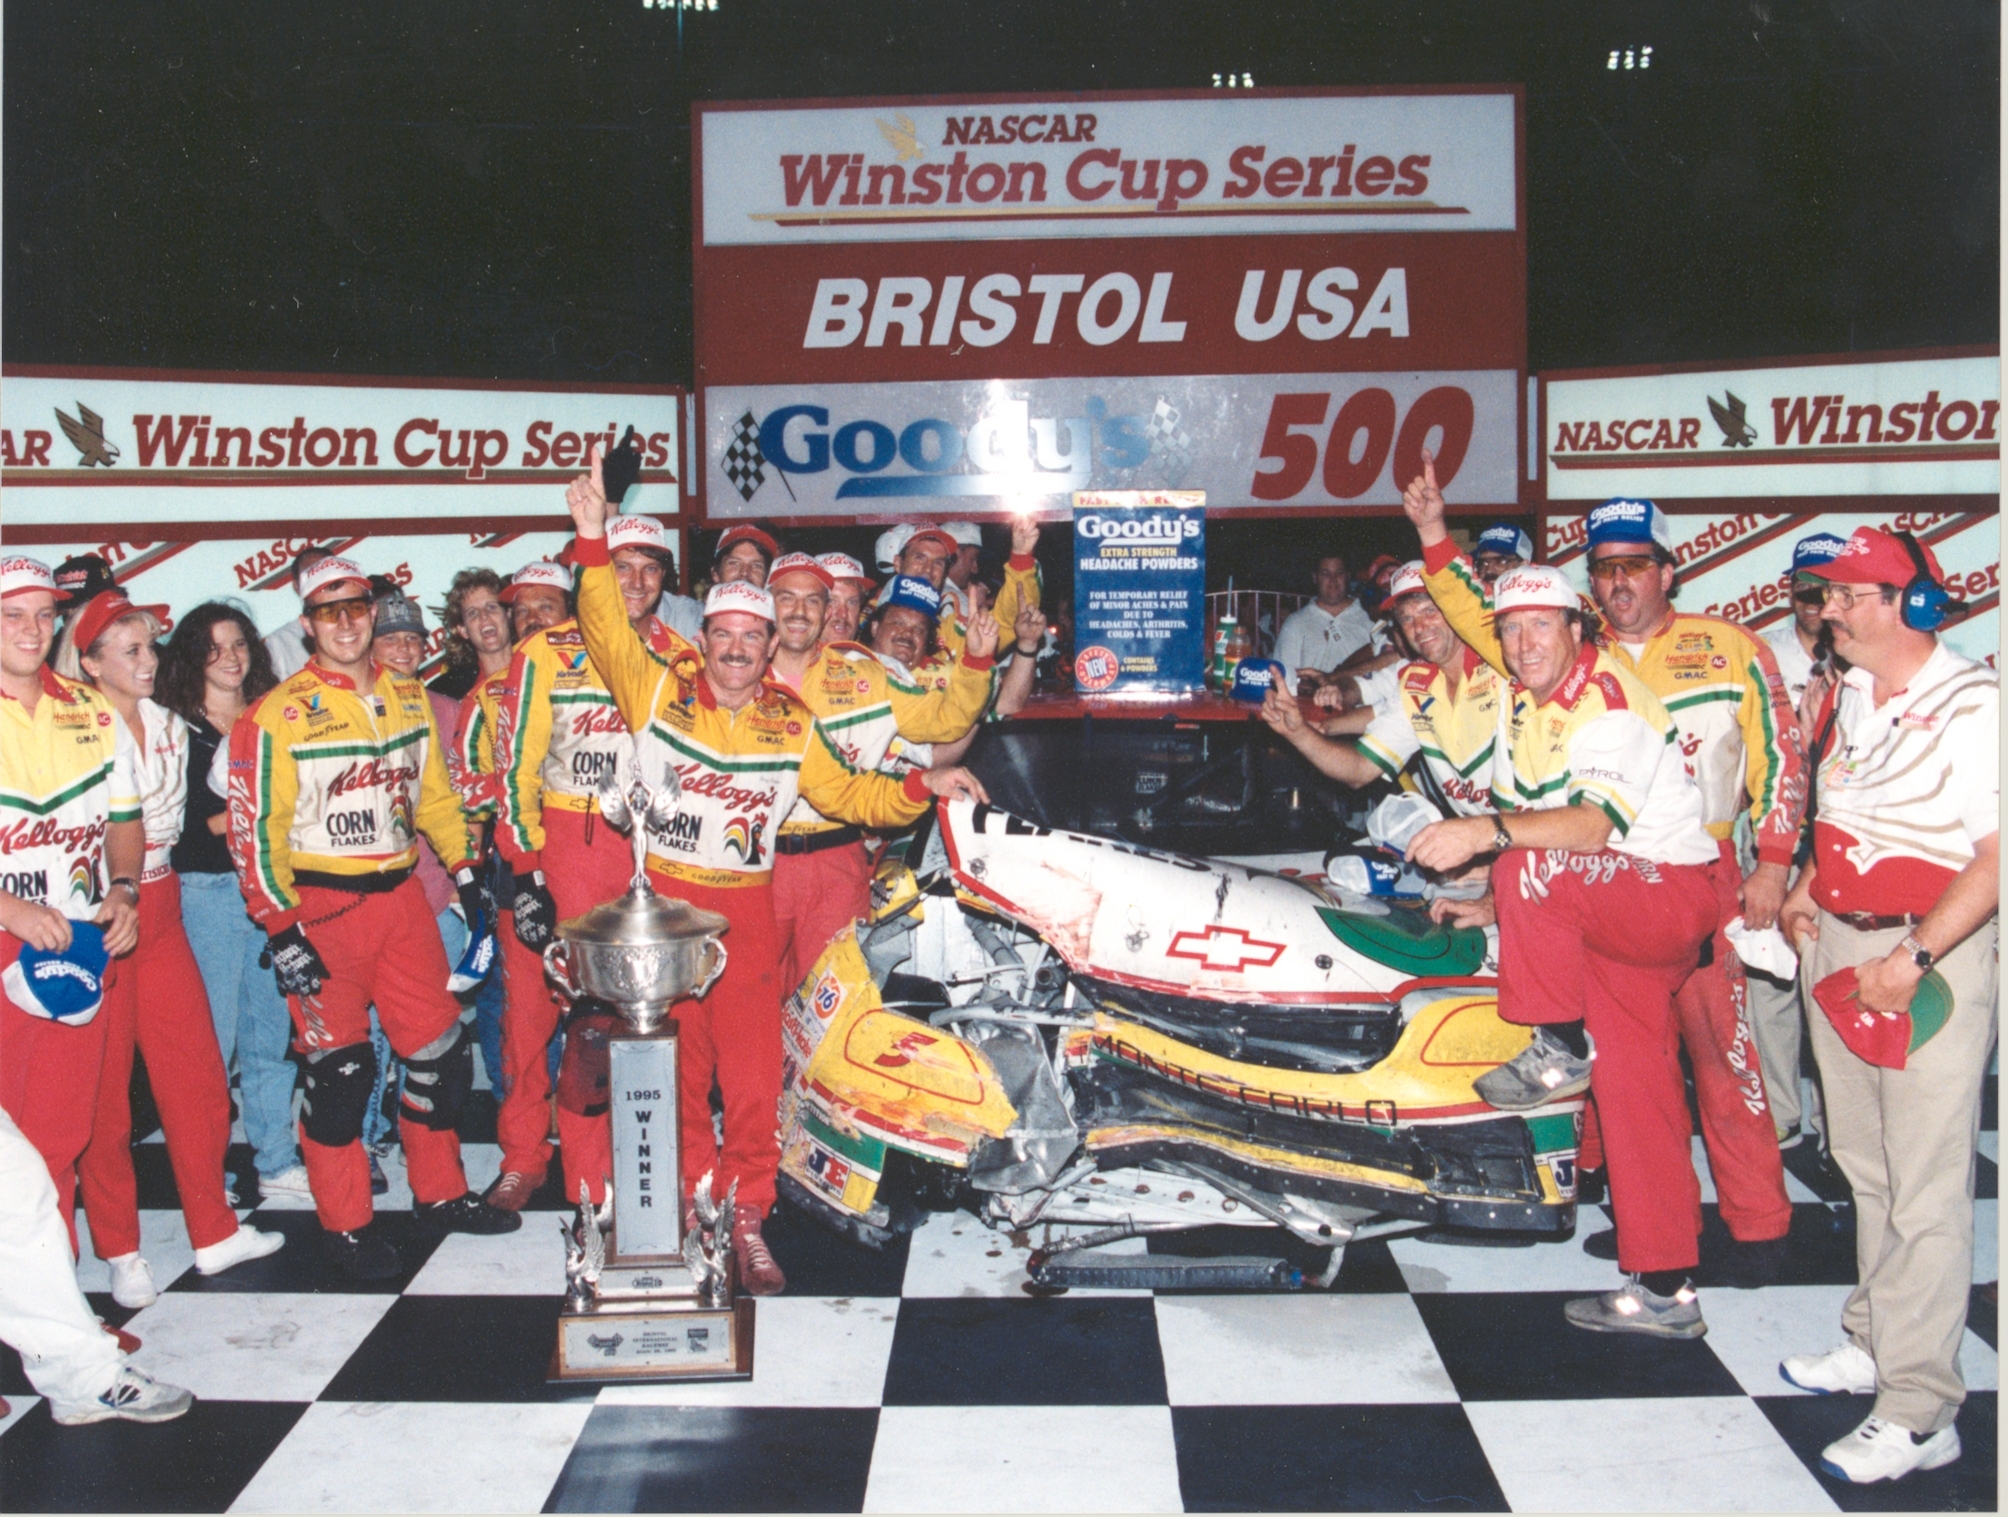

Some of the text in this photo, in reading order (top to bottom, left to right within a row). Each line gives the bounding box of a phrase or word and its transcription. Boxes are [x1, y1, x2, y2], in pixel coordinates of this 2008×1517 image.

[943, 114, 1097, 145] NASCAR
[779, 144, 1431, 211] Winston Cup Series
[803, 266, 1411, 349] BRISTOL USA
[760, 385, 1476, 501] Goody's 500
[1555, 417, 1702, 451] NASCAR
[132, 414, 379, 469] Winston
[391, 418, 509, 480] Cup
[521, 420, 670, 468] Series
[1590, 501, 1646, 520] Goody's
[611, 518, 660, 536] Kellogg's
[1077, 514, 1201, 546] Goody's
[1100, 547, 1177, 557] EXTRA STRENGTH
[1080, 557, 1198, 571] HEADACHE POWDERS
[715, 582, 769, 604] Kellogg's
[1089, 591, 1189, 600] FOR TEMPORARY RELIEF
[1089, 601, 1189, 610] OF MINOR ACHES & PAIN
[1123, 611, 1154, 619] DUE TO
[1107, 630, 1171, 639] COLDS & FEVER
[1665, 653, 1709, 665] Hendrick
[1674, 671, 1709, 680] GMAC
[828, 697, 856, 706] GMAC
[756, 735, 786, 746] GMAC
[328, 757, 421, 799] Kellogg's
[326, 808, 377, 837] CORN
[1, 814, 109, 856] Kellogg's
[331, 834, 377, 848] FLAKES
[658, 835, 698, 852] FLAKES
[1, 869, 49, 899] ORN
[817, 985, 838, 1012] 76
[873, 1031, 940, 1069] 5
[625, 1090, 662, 1101] 1995
[635, 1110, 653, 1208] WINNER
[808, 1146, 851, 1190] JE
